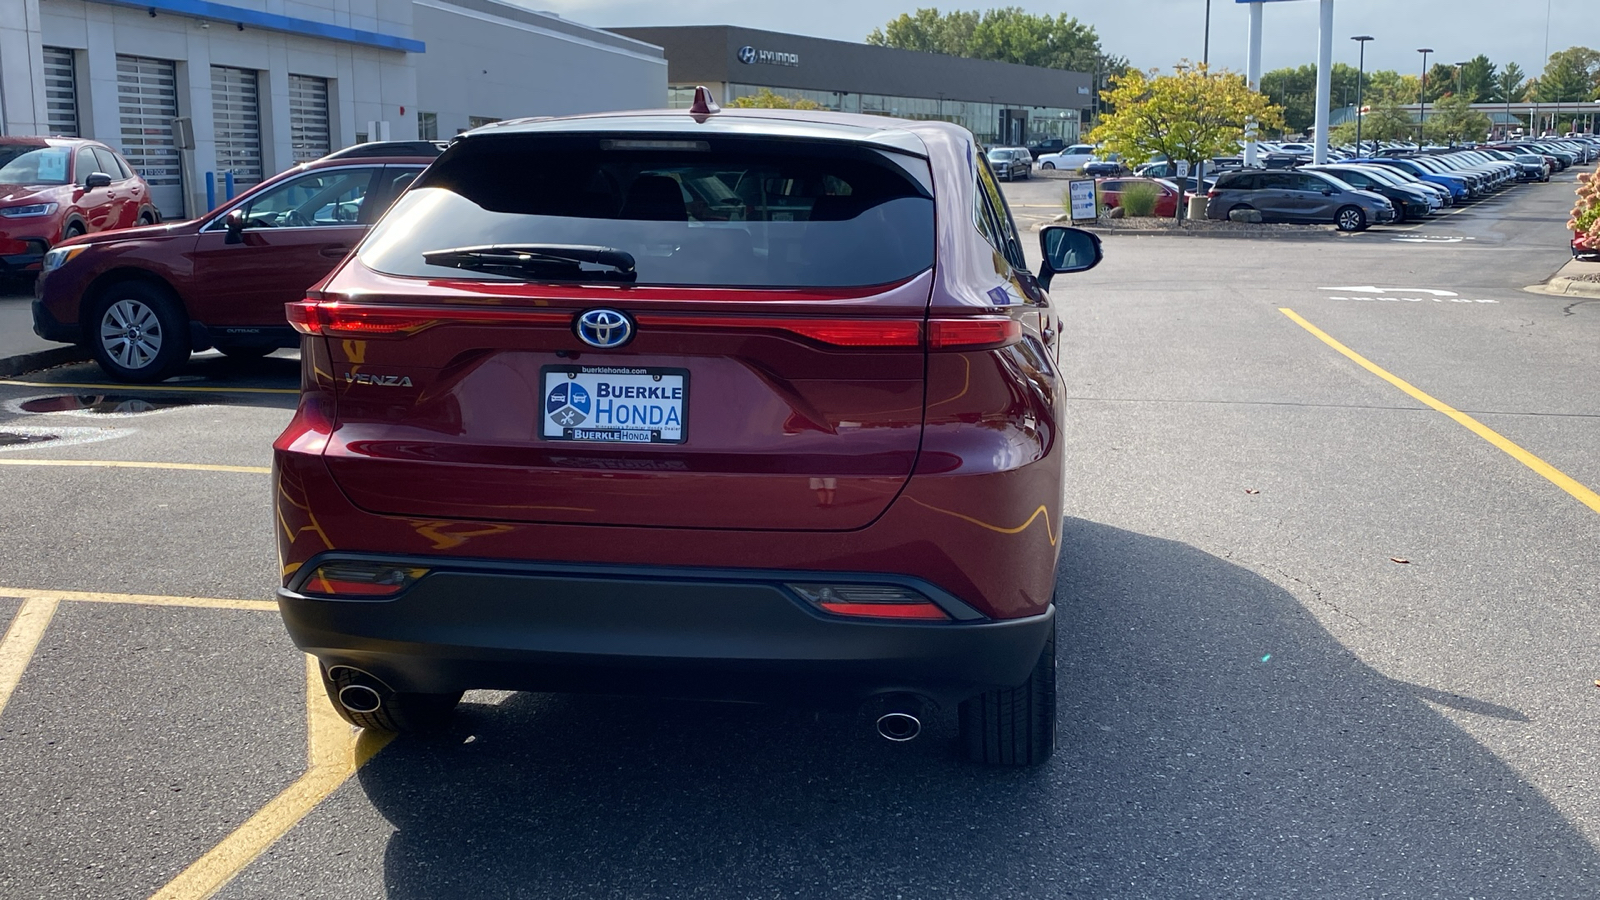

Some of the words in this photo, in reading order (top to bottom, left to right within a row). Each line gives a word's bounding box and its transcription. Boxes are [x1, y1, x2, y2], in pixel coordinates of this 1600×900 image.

[759, 50, 799, 63] HYUNDAI
[581, 366, 647, 375] buerklehonda.com
[344, 372, 413, 387] VENZA
[596, 382, 682, 400] BUERKLE
[595, 399, 681, 426] HONDA
[574, 429, 620, 440] BUERKLE
[621, 431, 650, 441] HONDA
